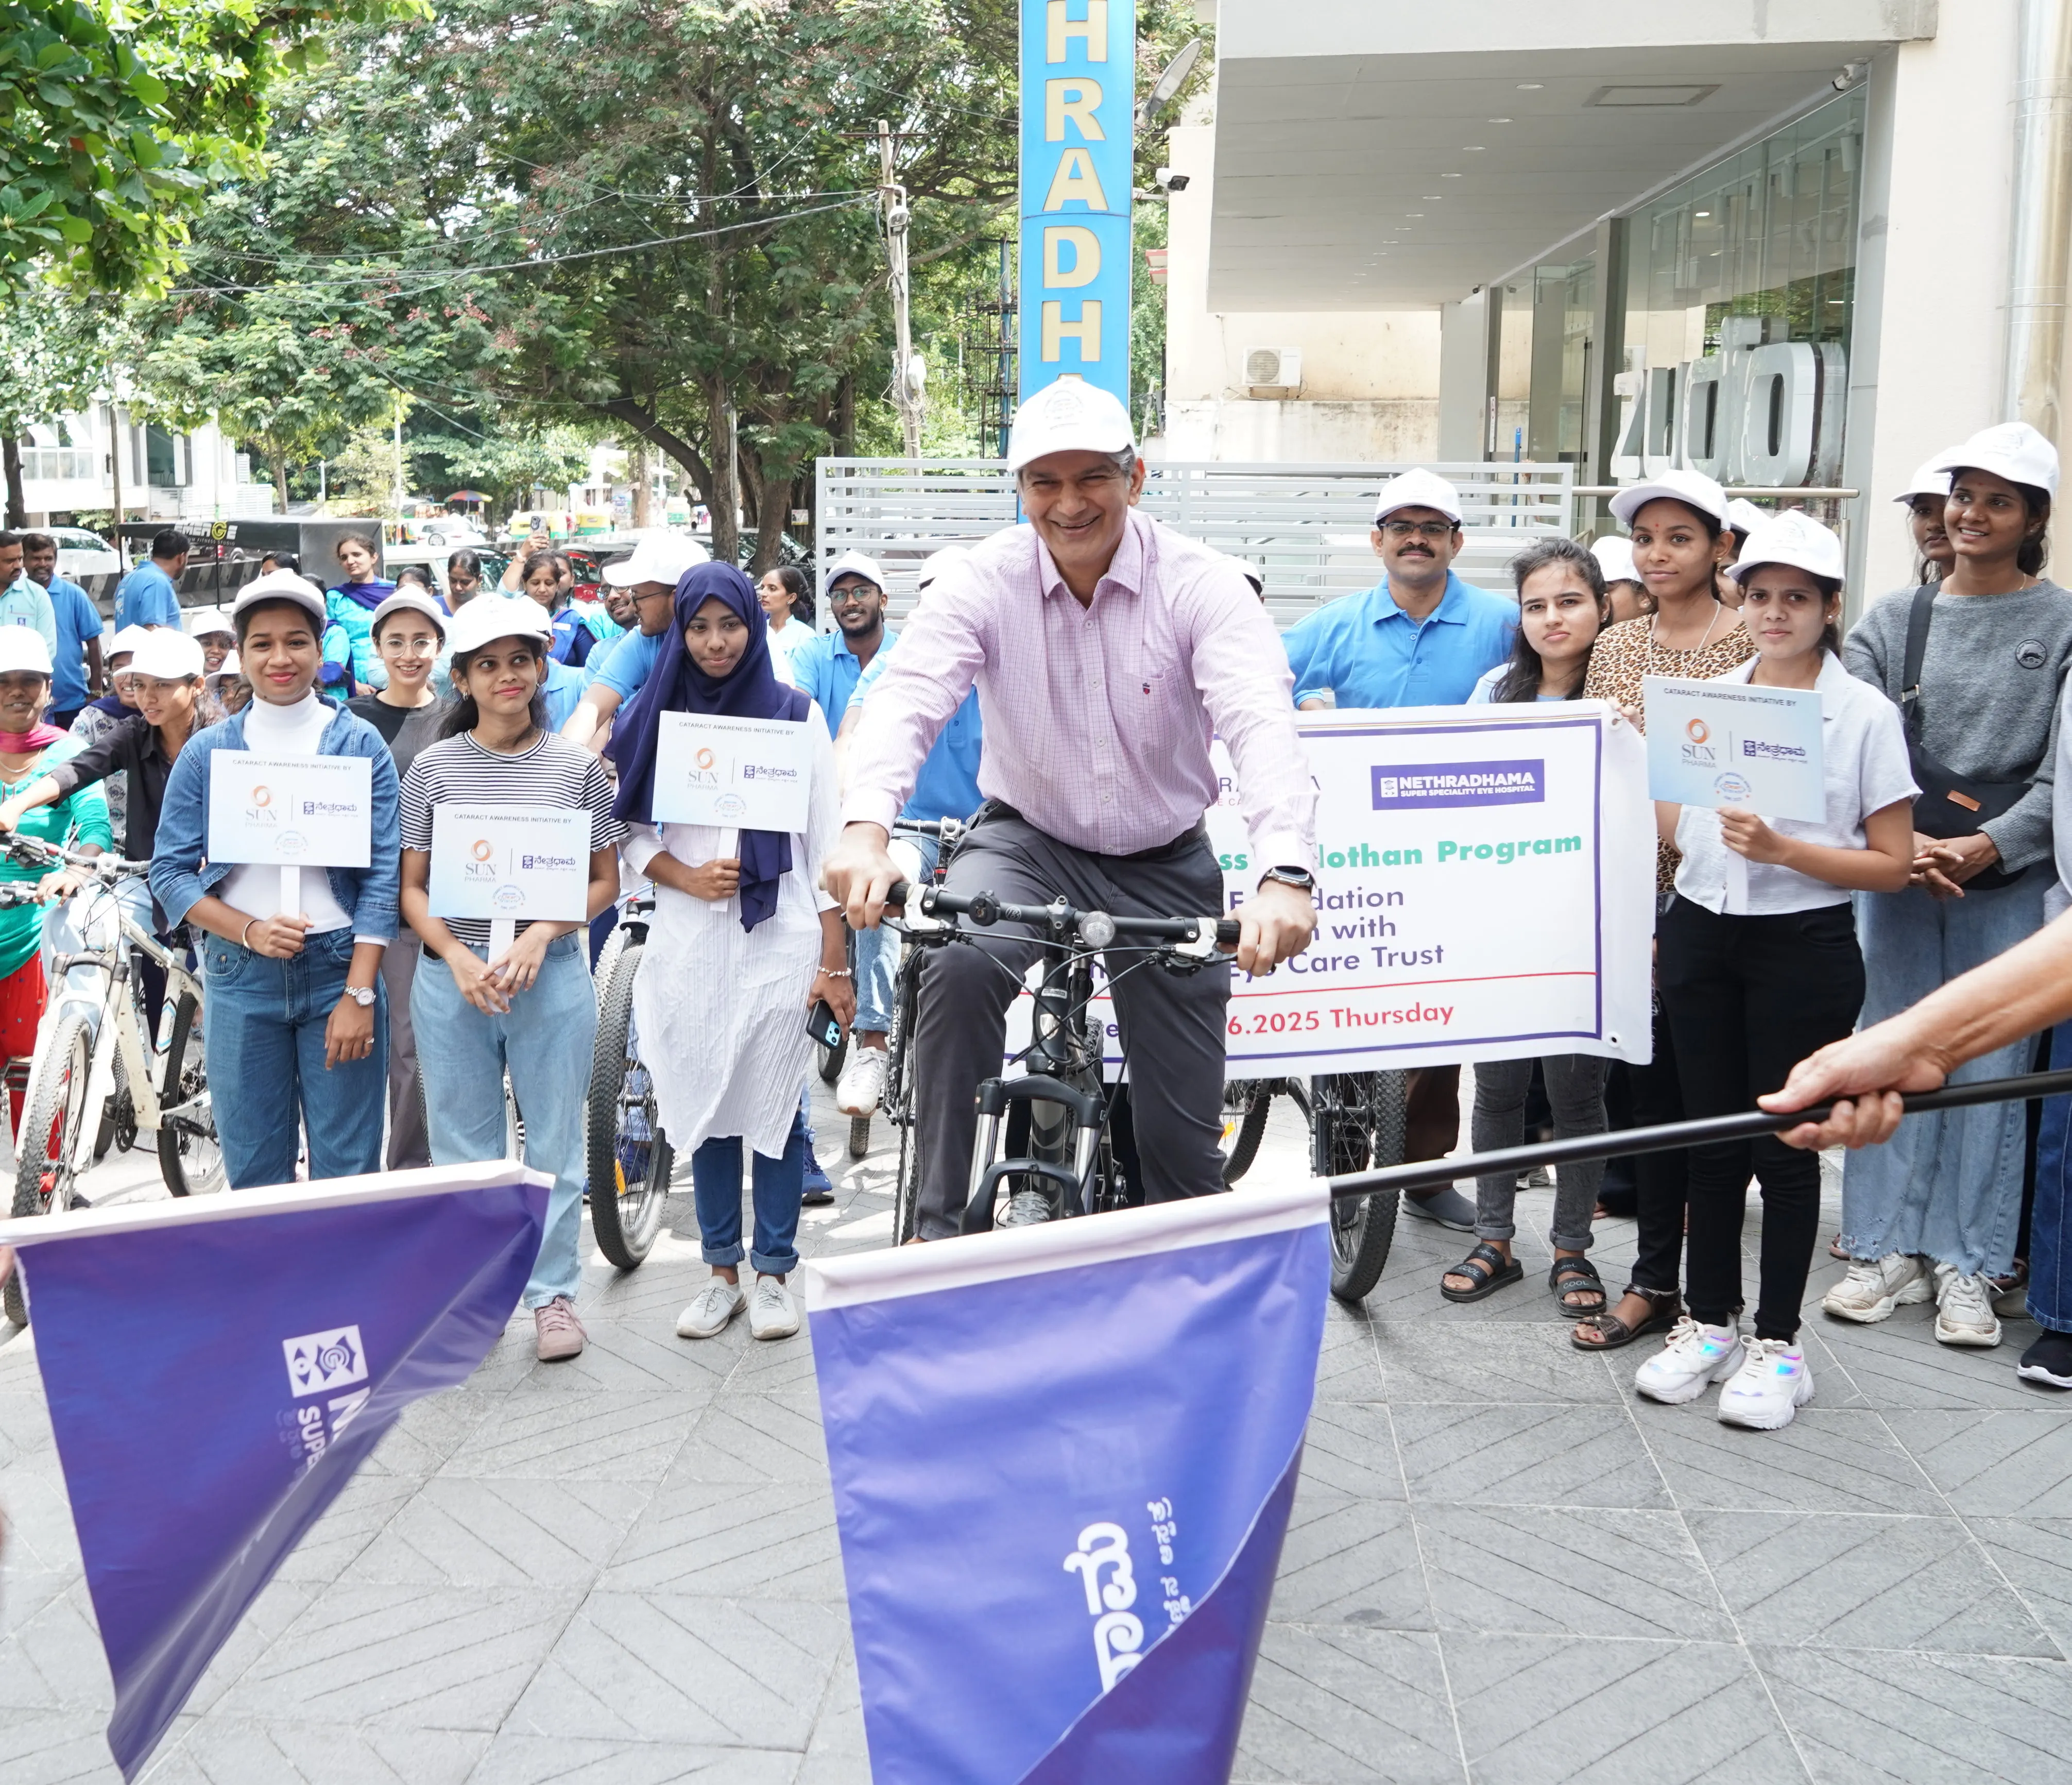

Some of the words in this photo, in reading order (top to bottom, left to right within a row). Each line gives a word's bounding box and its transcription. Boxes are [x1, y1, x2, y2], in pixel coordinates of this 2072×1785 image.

[1040, 0, 1109, 380] HRADH
[1664, 688, 1701, 696] CATARACT
[1702, 692, 1746, 702] AWARENESS
[1748, 696, 1785, 706] INITIATIVE
[1682, 744, 1716, 760] SUN
[1682, 759, 1717, 769] PHARMA
[688, 770, 718, 784] SUN
[1399, 772, 1535, 790] NETHRADHAMA
[1400, 789, 1427, 797] SUPER
[1429, 788, 1476, 797] SPECIALITY
[1495, 785, 1535, 794] HOSPITAL
[246, 809, 277, 822] SUN
[1437, 836, 1582, 864] Program
[466, 863, 496, 876] SUN
[1331, 915, 1396, 939] with
[1288, 951, 1360, 973] Care
[1371, 945, 1444, 967] Trust
[1330, 1002, 1454, 1028] Thursday
[1458, 1265, 1480, 1277] COOL
[1563, 1280, 1589, 1289] COOL
